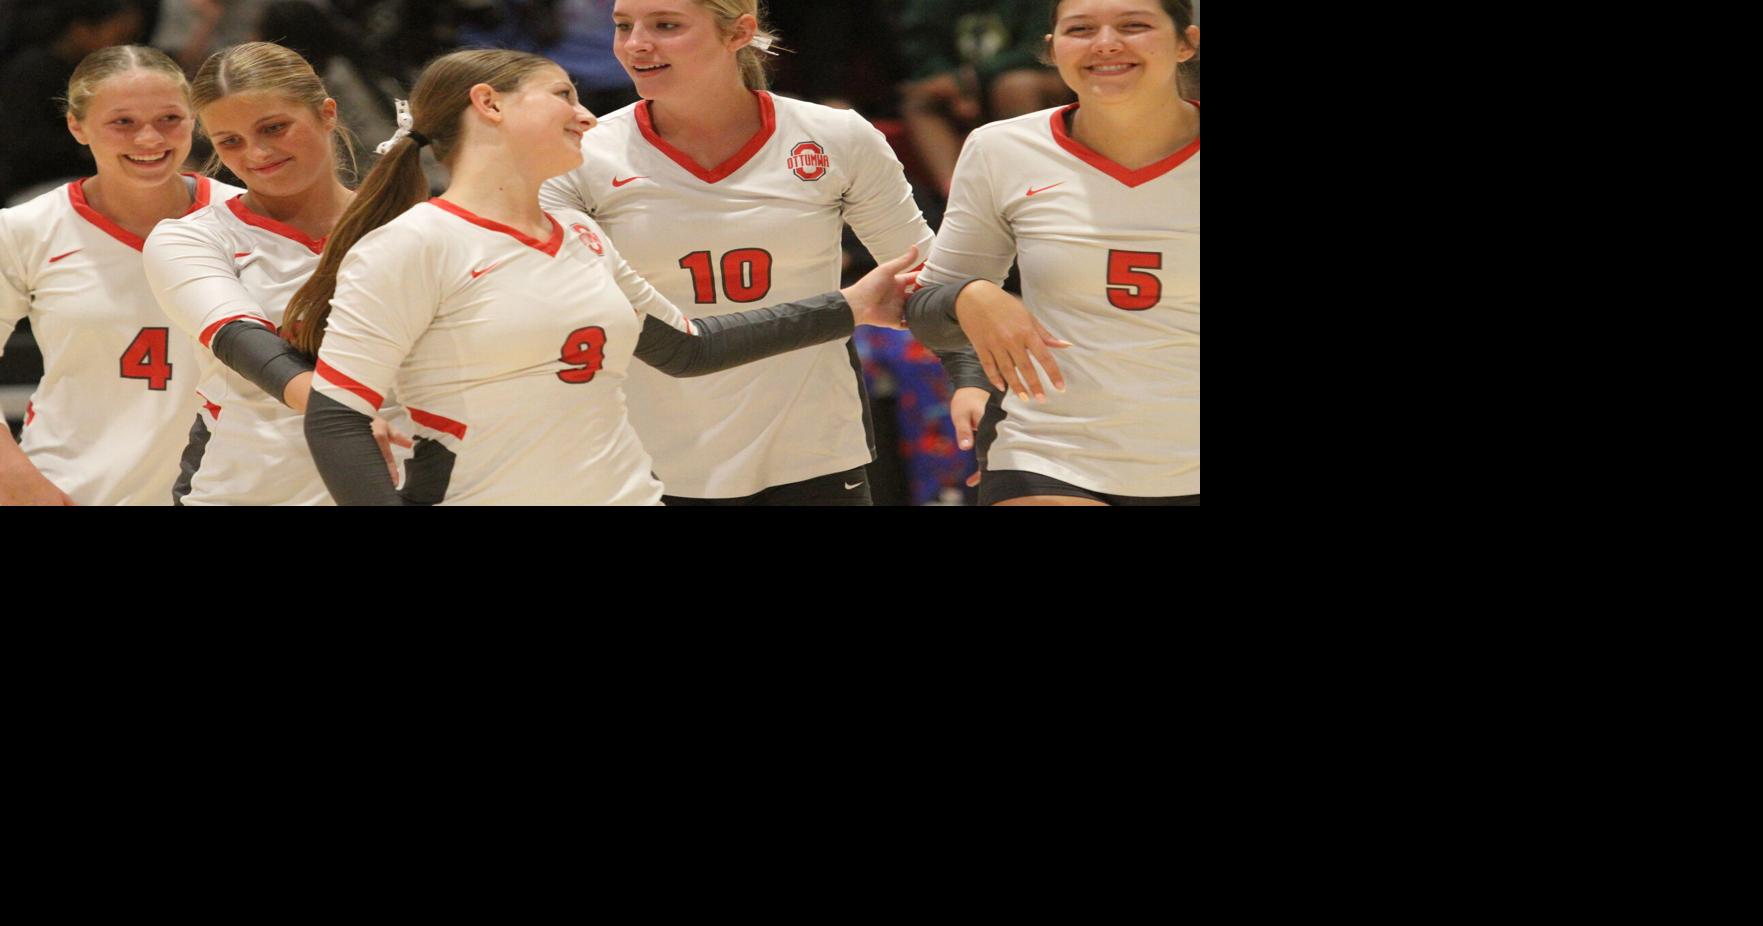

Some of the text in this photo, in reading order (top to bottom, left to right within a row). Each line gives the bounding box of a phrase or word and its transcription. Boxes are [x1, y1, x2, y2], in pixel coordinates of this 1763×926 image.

[787, 154, 829, 169] OTTUMWA
[678, 248, 773, 304] 10
[1106, 249, 1163, 311] 5
[119, 327, 173, 391] 4
[555, 326, 607, 384] 9
